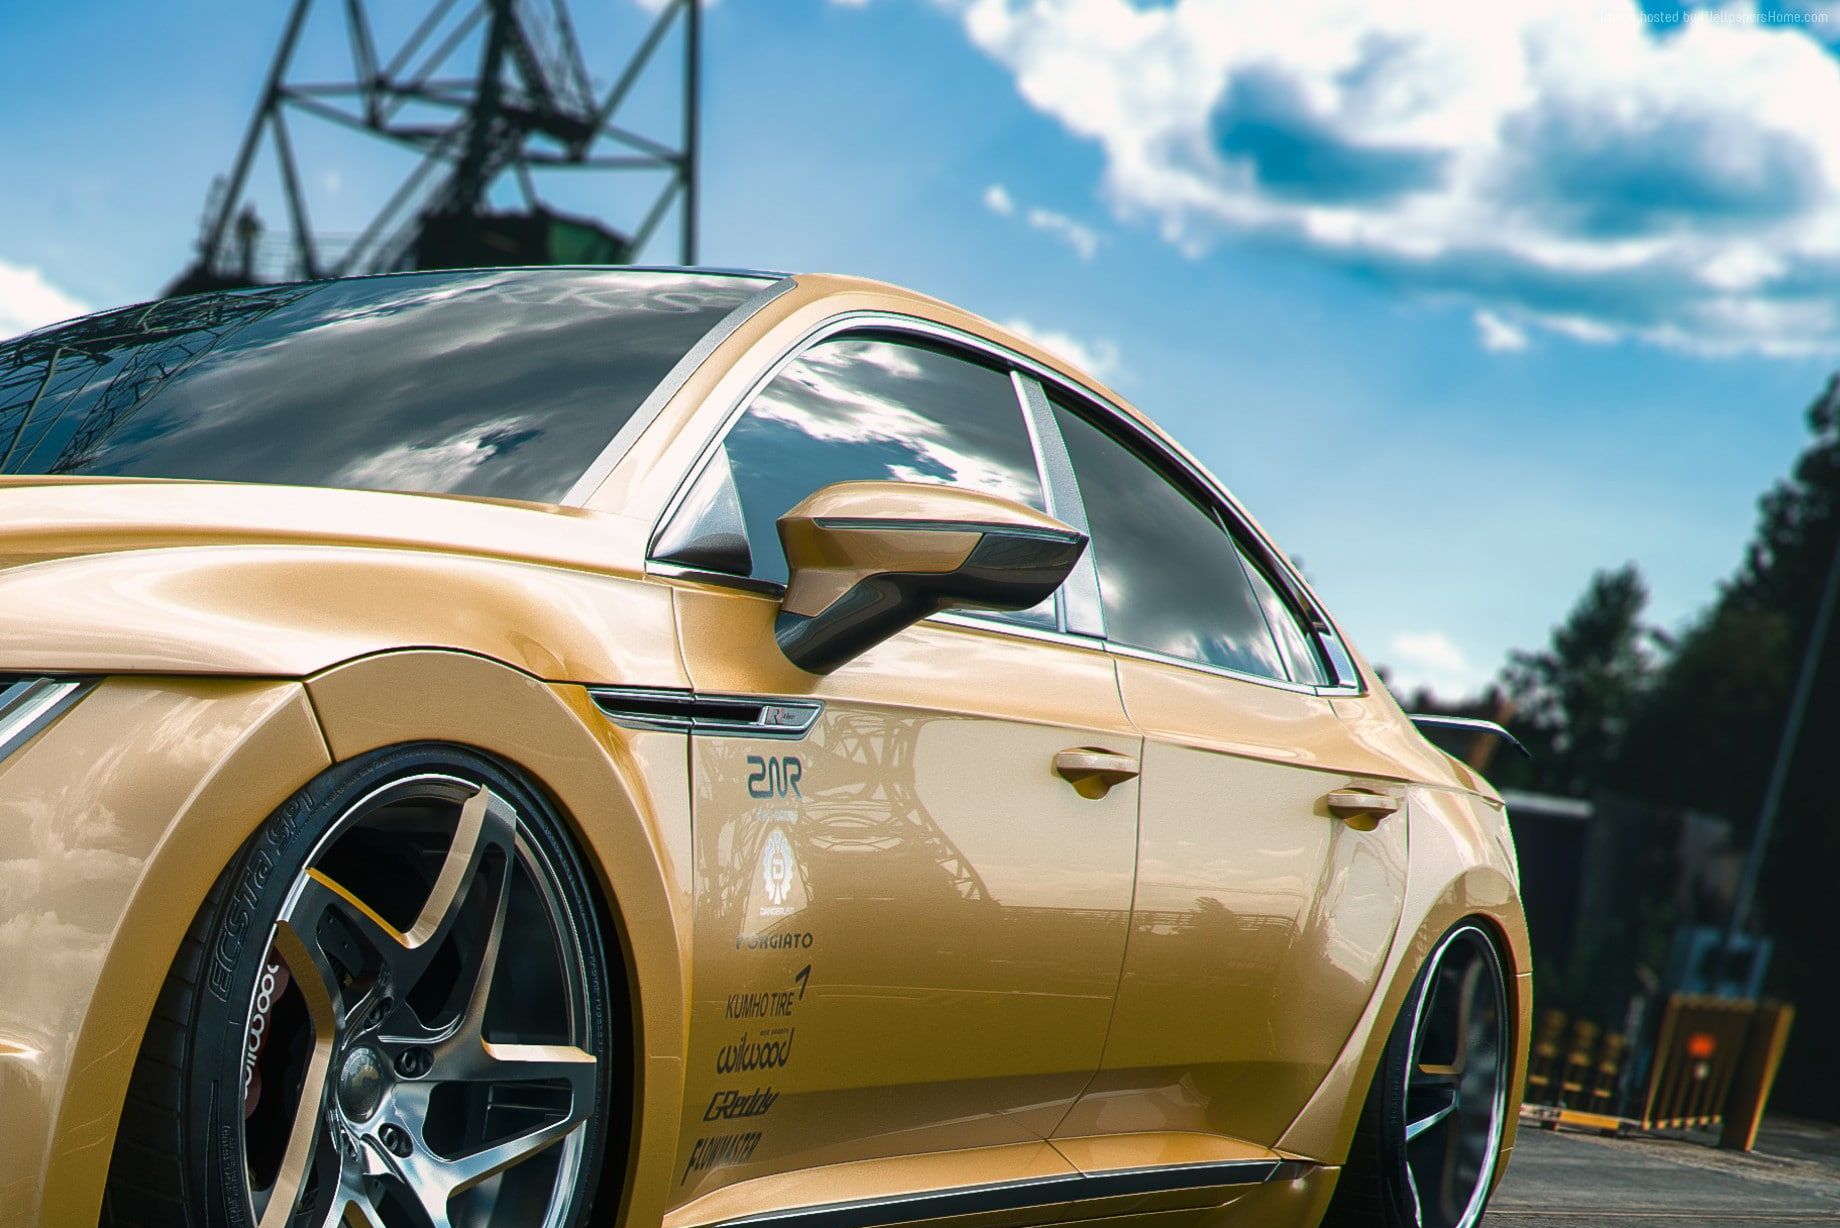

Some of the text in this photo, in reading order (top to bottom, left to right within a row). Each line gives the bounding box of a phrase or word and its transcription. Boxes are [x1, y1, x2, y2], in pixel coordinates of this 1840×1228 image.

[726, 991, 795, 1019] KUMHO TIRE
[716, 1027, 795, 1075] wilwood
